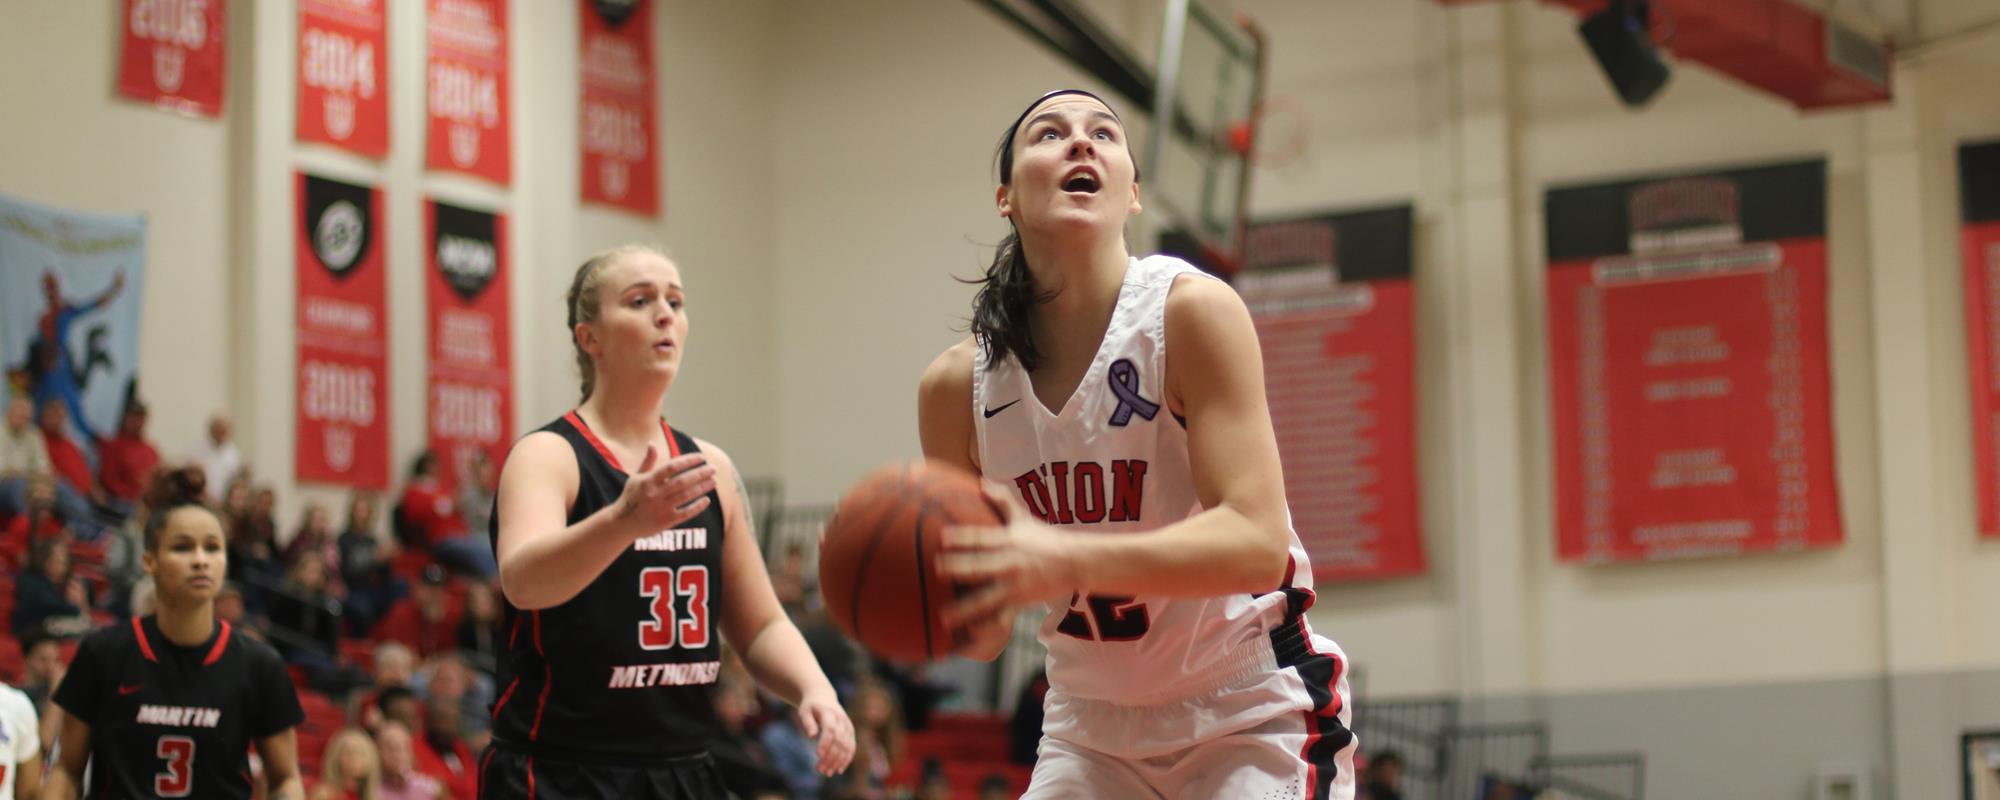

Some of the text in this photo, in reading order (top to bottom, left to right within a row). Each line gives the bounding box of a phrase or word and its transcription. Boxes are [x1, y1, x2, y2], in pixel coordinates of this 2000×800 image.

[303, 27, 376, 99] 2014
[304, 360, 376, 427] 2016
[638, 565, 710, 650] 33
[136, 704, 221, 728] MARTIN
[155, 735, 196, 797] 3
